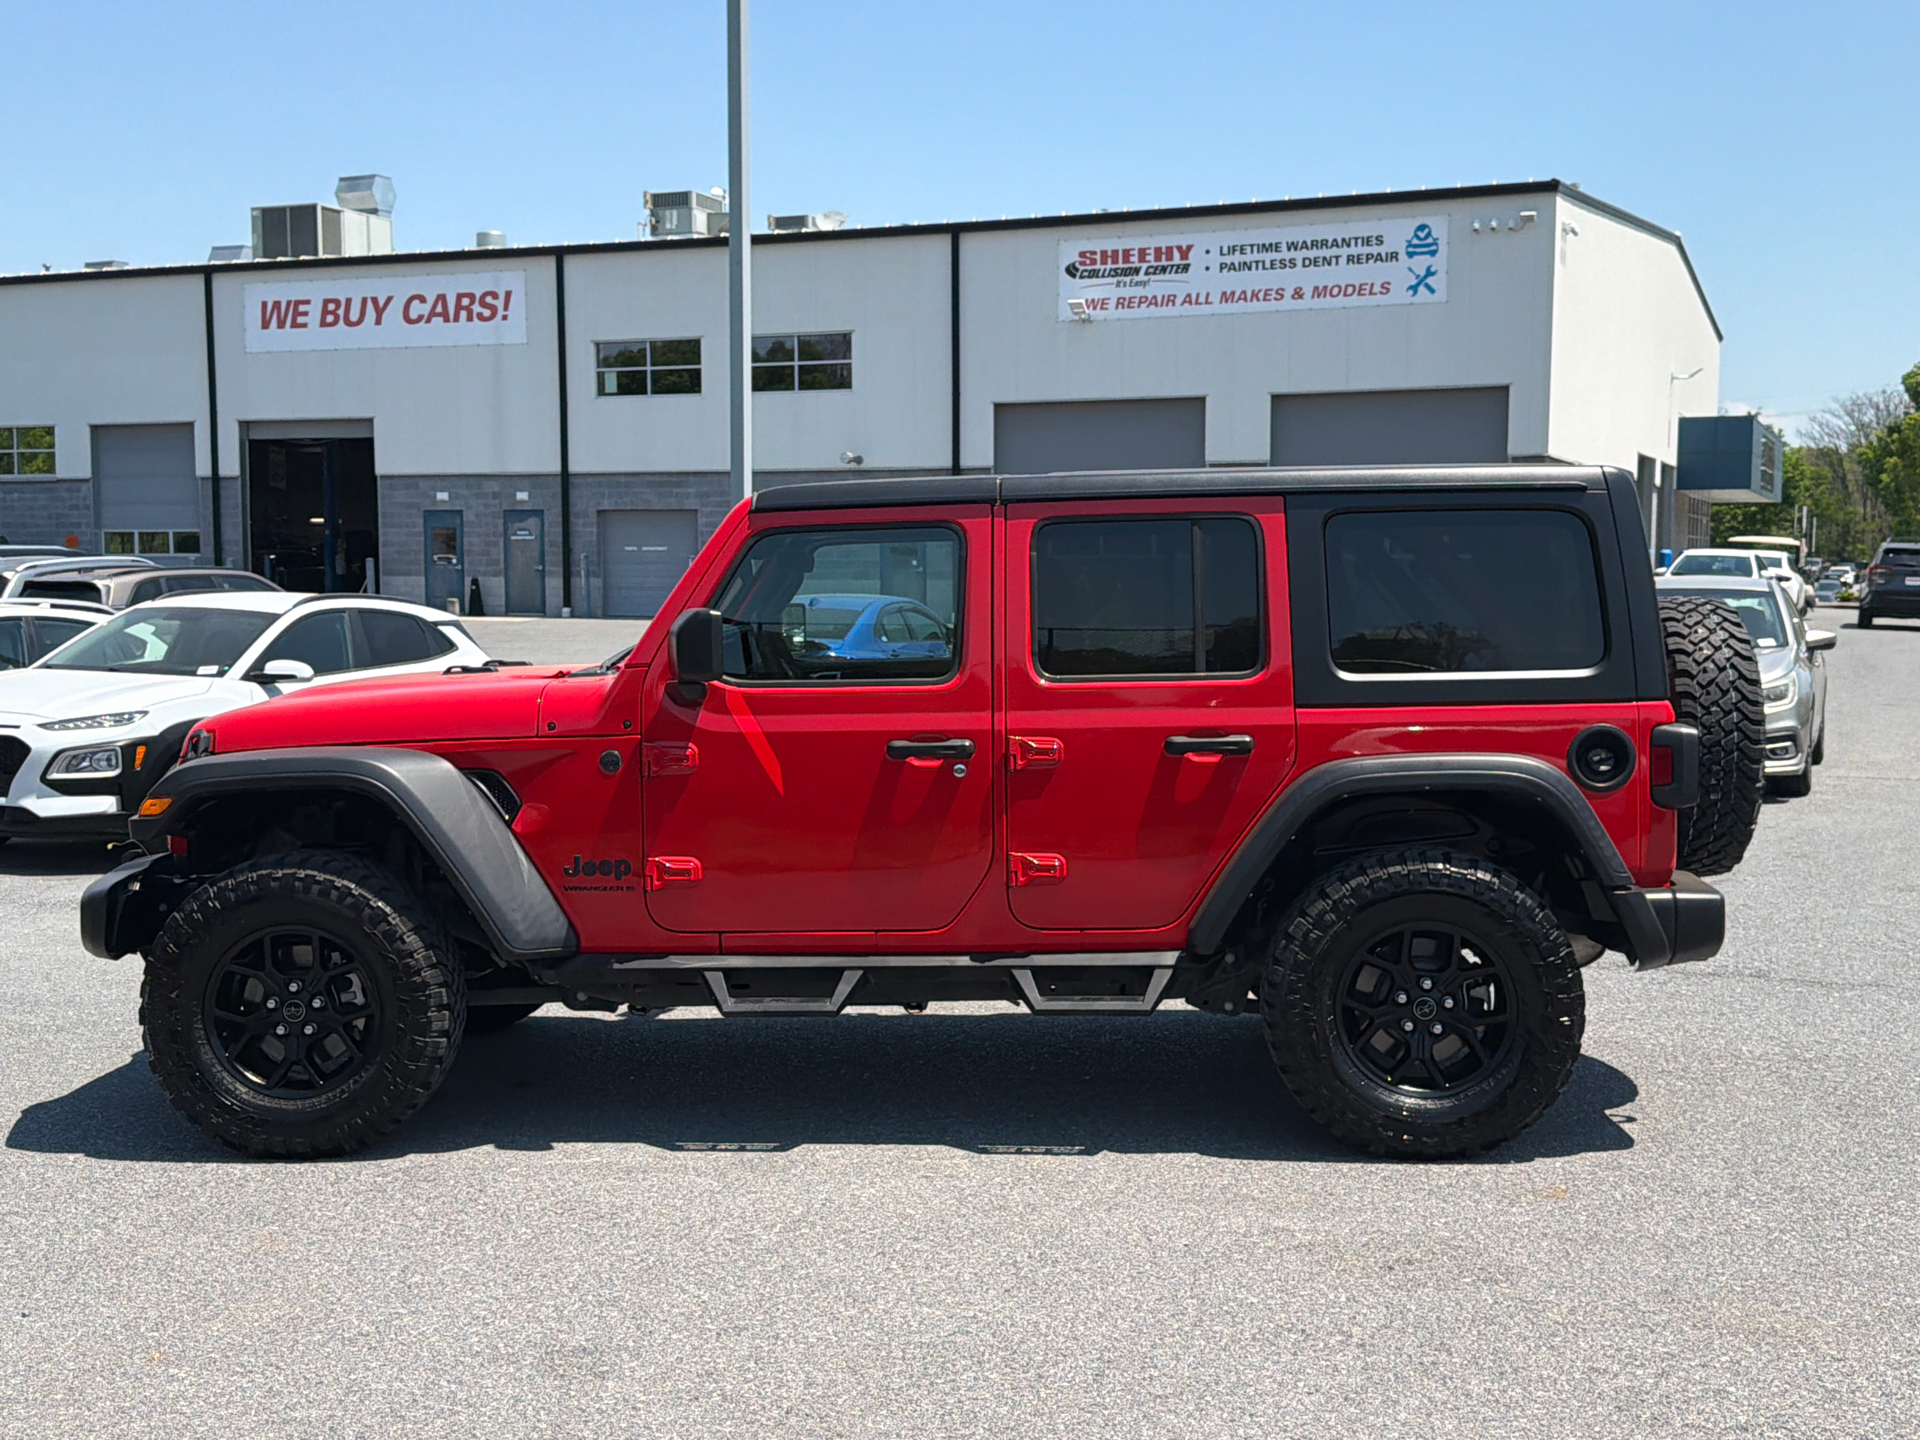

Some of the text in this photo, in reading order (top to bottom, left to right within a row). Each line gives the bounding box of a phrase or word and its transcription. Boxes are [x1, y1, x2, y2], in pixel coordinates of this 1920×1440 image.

[1078, 244, 1194, 267] SHEEHY
[1219, 234, 1384, 256] LIFETIME WARRANTIES
[1078, 263, 1191, 280] COLLISION CENTER
[1219, 251, 1399, 273] PAINTLESS DENT REPAIR
[1115, 278, 1151, 289] It's Easy!
[1084, 281, 1392, 311] WE REPAIR ALL MAKES & MODELS
[260, 289, 513, 330] WE BUY CARS!
[563, 854, 632, 881] Jeep
